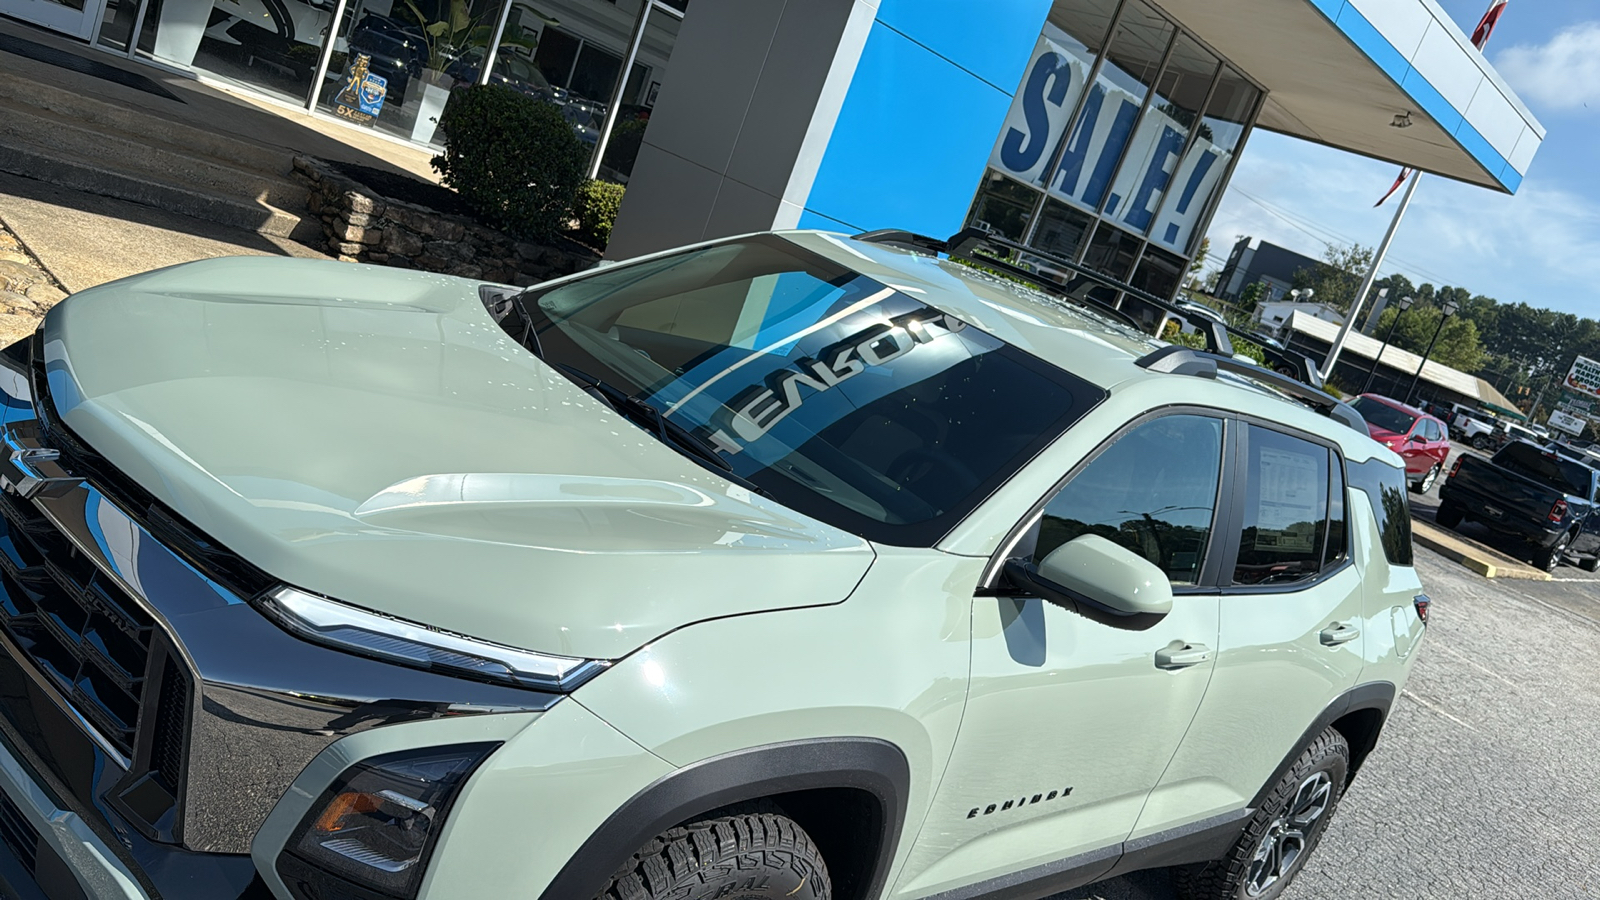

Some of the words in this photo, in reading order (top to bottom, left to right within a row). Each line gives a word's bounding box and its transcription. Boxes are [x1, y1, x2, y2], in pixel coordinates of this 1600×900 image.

[336, 104, 355, 118] 5X
[1000, 51, 1218, 245] SALE!
[966, 786, 1074, 819] EQUINOX
